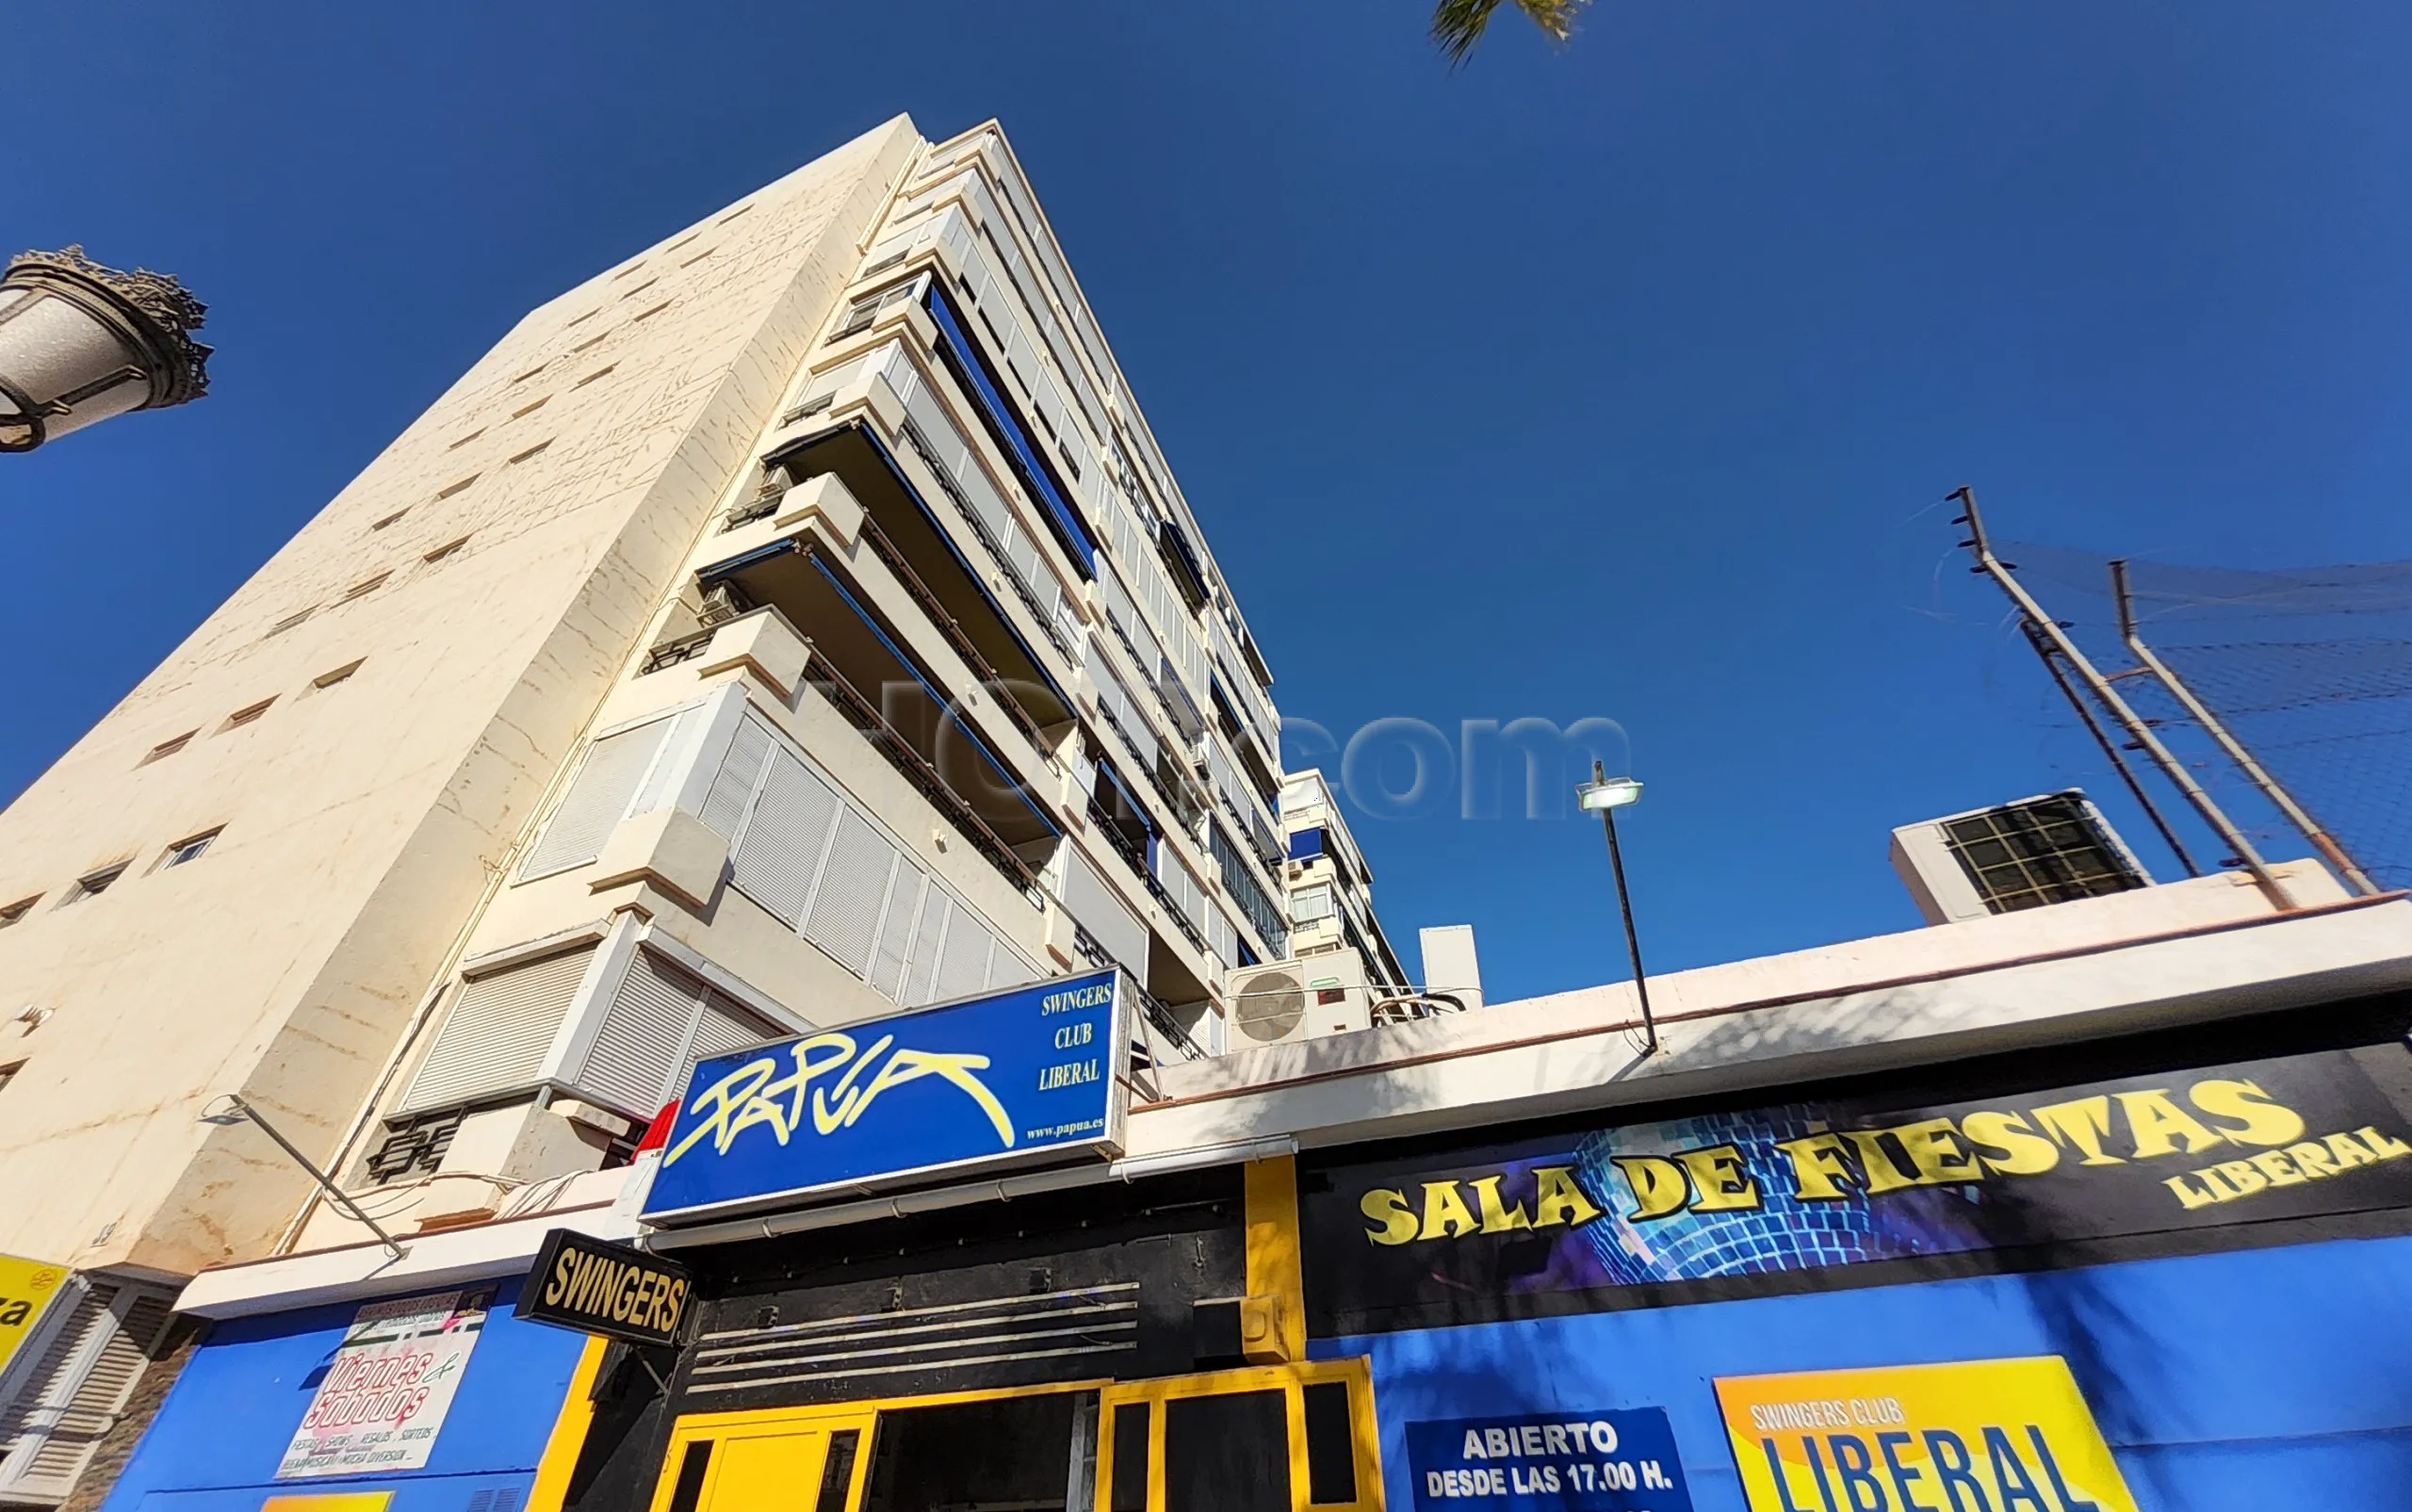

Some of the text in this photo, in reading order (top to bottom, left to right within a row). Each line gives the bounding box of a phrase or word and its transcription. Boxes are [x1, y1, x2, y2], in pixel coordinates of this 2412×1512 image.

[1041, 983, 1113, 1016] SWINGERS
[1054, 1022, 1093, 1049] CLUB
[1038, 1058, 1100, 1091] LIBERAL
[1026, 1117, 1104, 1140] www.papua.es
[1359, 1079, 2306, 1246] SALA DE FIESTAS
[2160, 1126, 2412, 1211] LIBERAL
[546, 1246, 685, 1333] SWINGERS
[322, 1353, 433, 1394] Viernes
[1750, 1396, 1906, 1432] SWINGERS CLUB
[1463, 1420, 1619, 1460] ABIERTO
[1426, 1459, 1673, 1499] DESDE LAS 17.00 H.
[1761, 1423, 2100, 1512] LIBERAL
